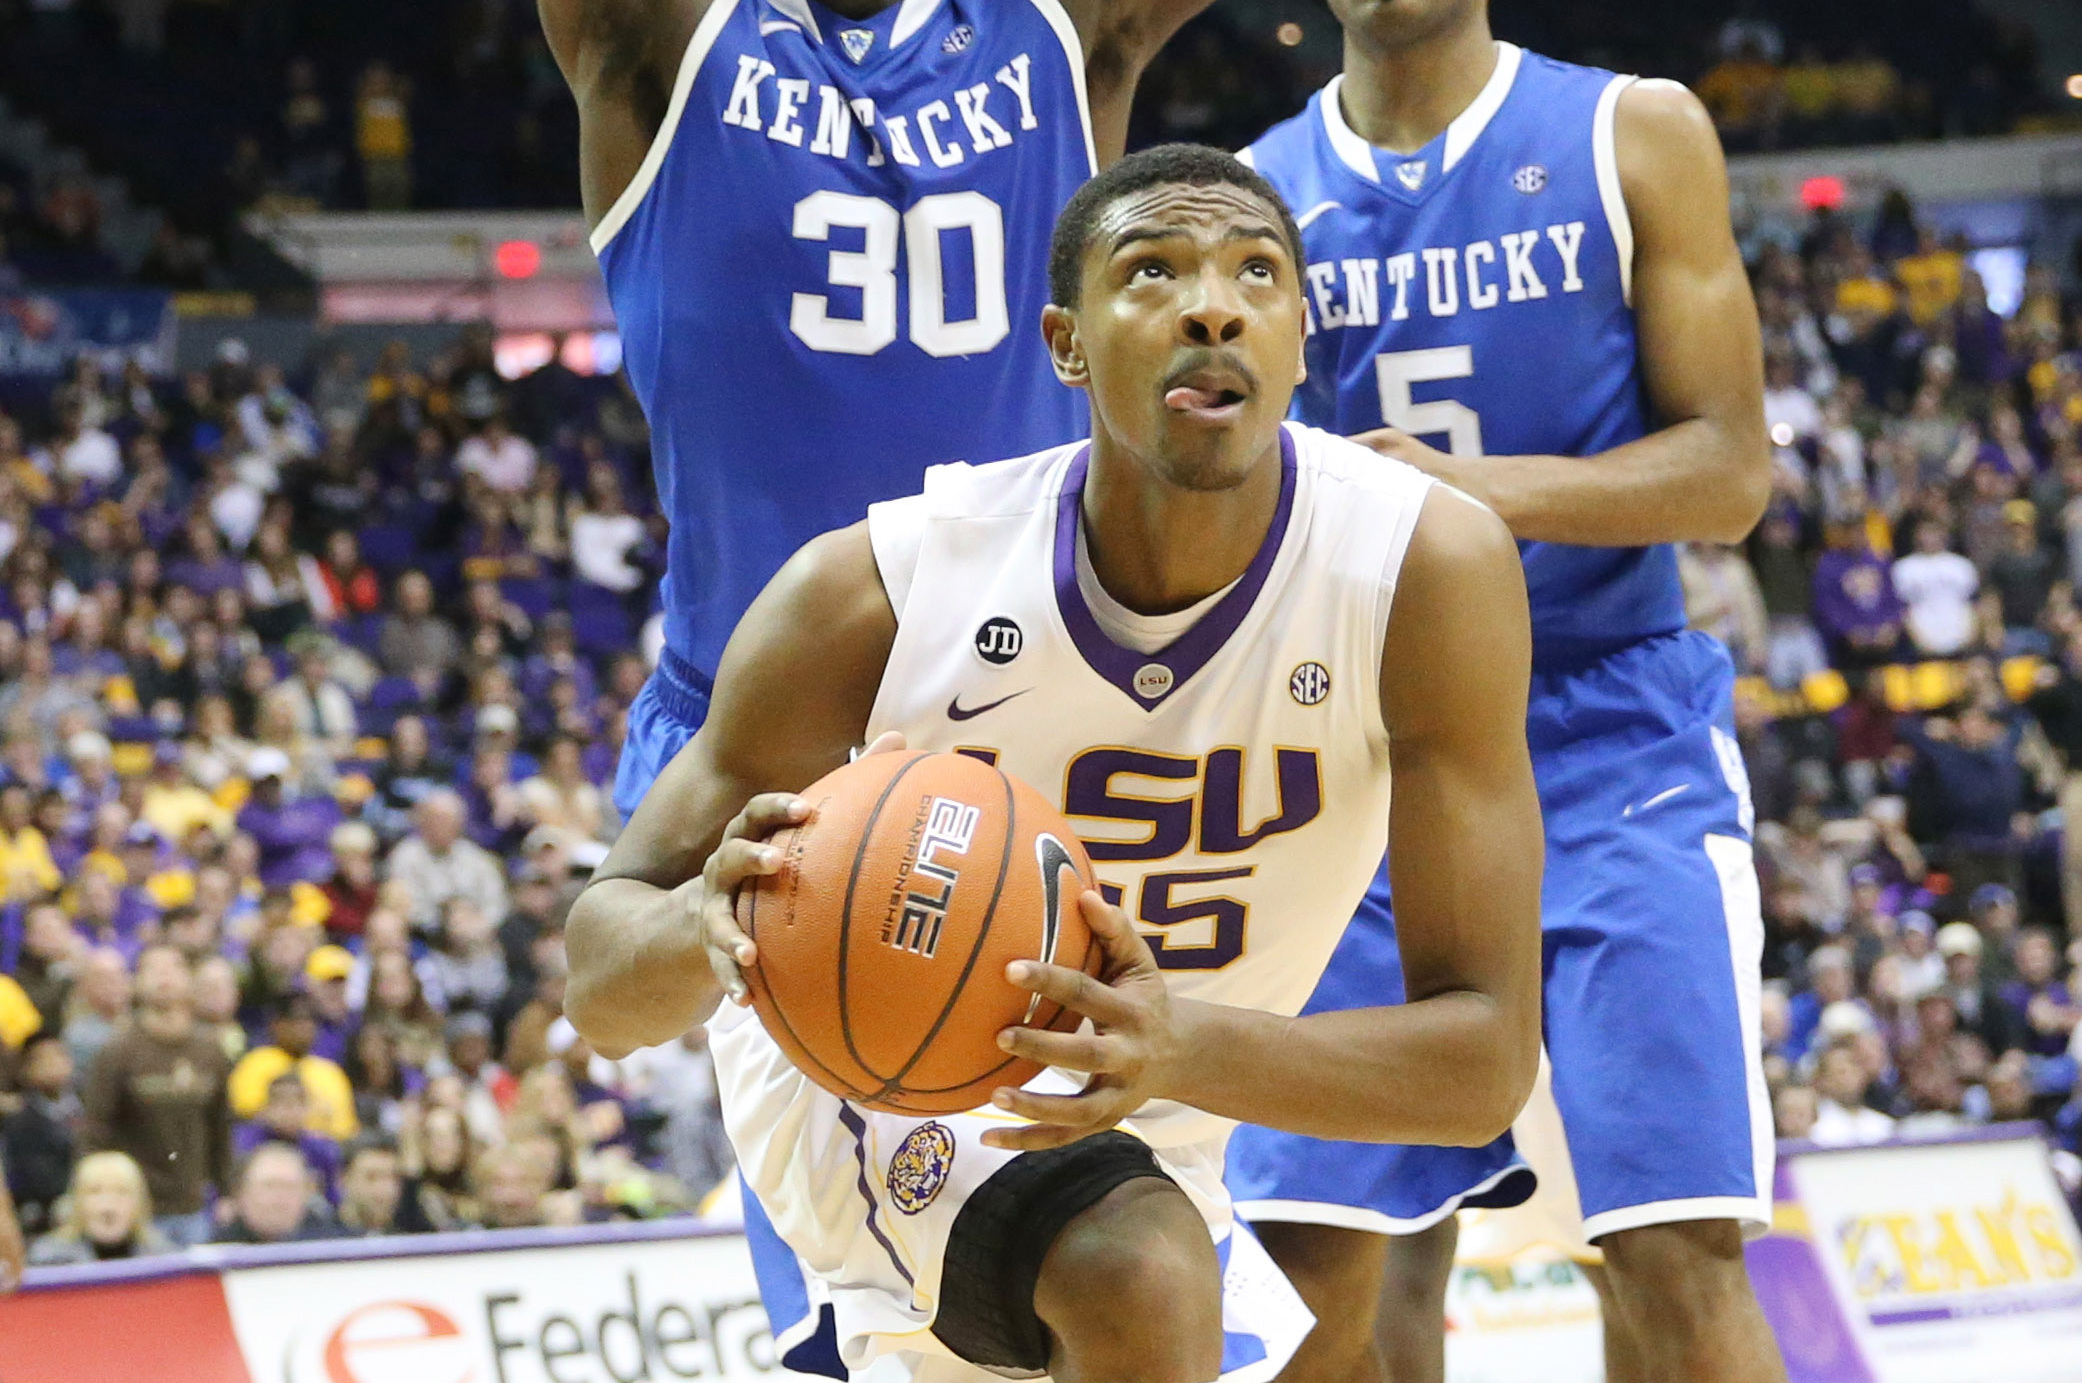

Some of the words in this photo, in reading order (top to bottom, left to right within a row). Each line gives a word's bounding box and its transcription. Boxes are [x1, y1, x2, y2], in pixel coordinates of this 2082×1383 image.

[722, 53, 1038, 168] KENTUCKY
[789, 189, 1010, 358] 30
[1303, 221, 1585, 335] ENTUCKY
[1376, 345, 1483, 457] 5
[979, 625, 1020, 655] JD
[1140, 676, 1167, 686] LSU
[1291, 663, 1328, 703] SEC
[953, 744, 1325, 864] SU
[879, 795, 932, 944] CHAMPIONSHIP
[1098, 864, 1259, 973] 5
